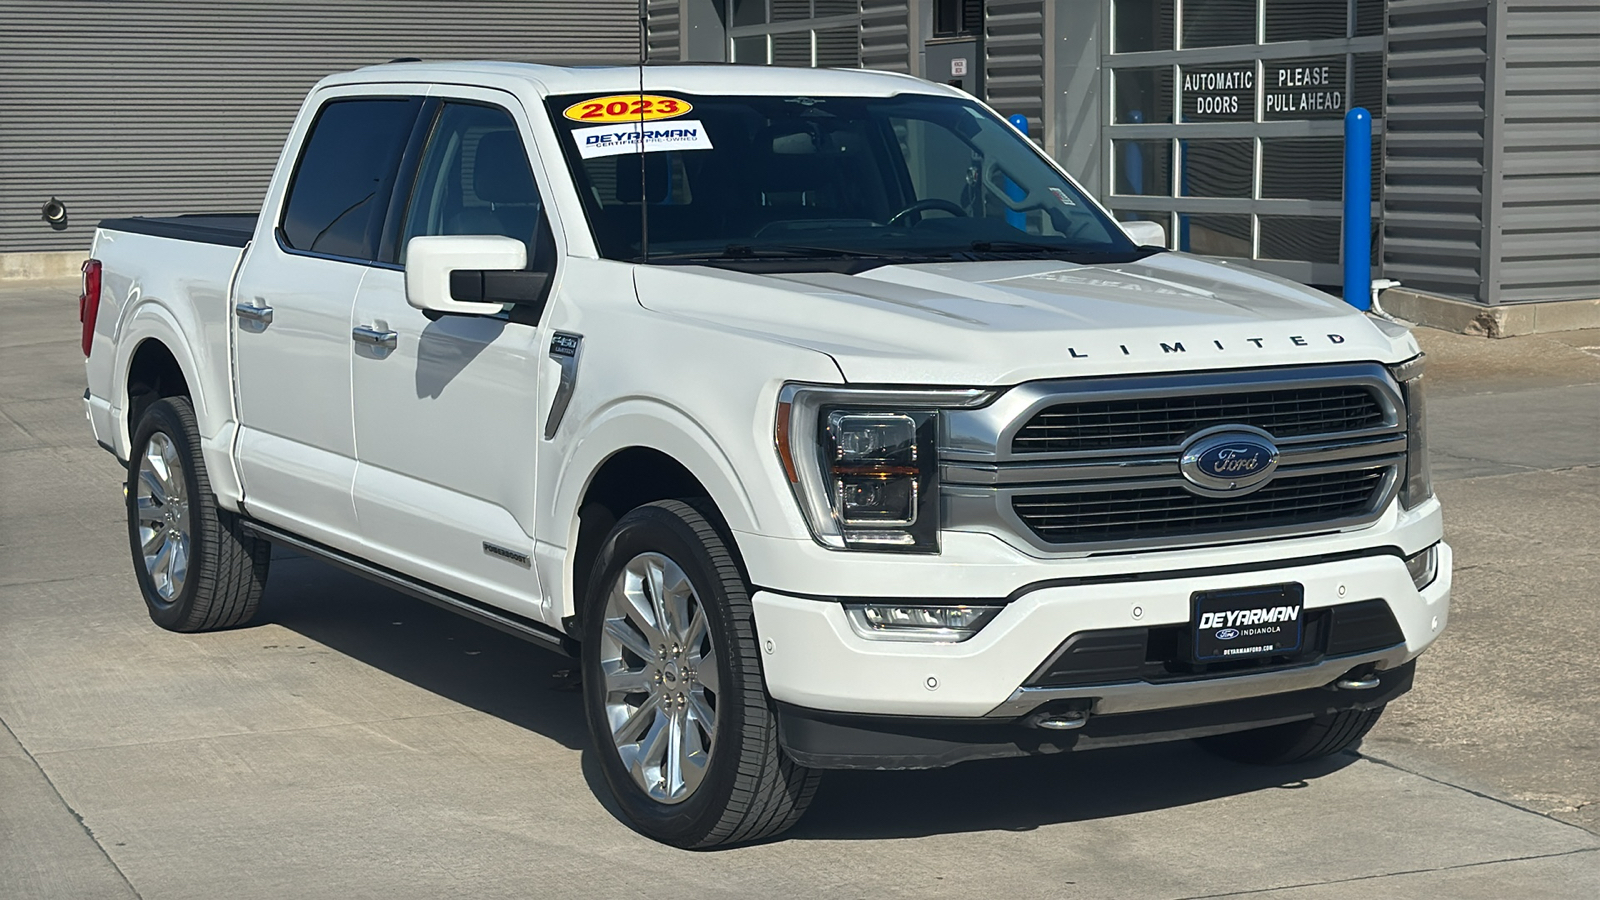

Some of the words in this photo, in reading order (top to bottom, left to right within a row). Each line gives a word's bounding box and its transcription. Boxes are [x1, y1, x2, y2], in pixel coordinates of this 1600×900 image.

[1184, 71, 1252, 91] AUTOMATIC
[1278, 67, 1329, 87] PLEASE
[581, 100, 679, 119] 2023
[1197, 96, 1238, 114] DOORS
[1266, 94, 1296, 112] PULL
[1300, 91, 1341, 110] AHEAD
[586, 129, 697, 145] DEYARMAN
[1068, 333, 1345, 358] LIMITED
[1214, 448, 1259, 473] Ford
[1199, 605, 1300, 630] DEYARMAN
[1241, 626, 1281, 636] INDIANOLA
[1223, 644, 1274, 656] DEYARMANFORD.COM
